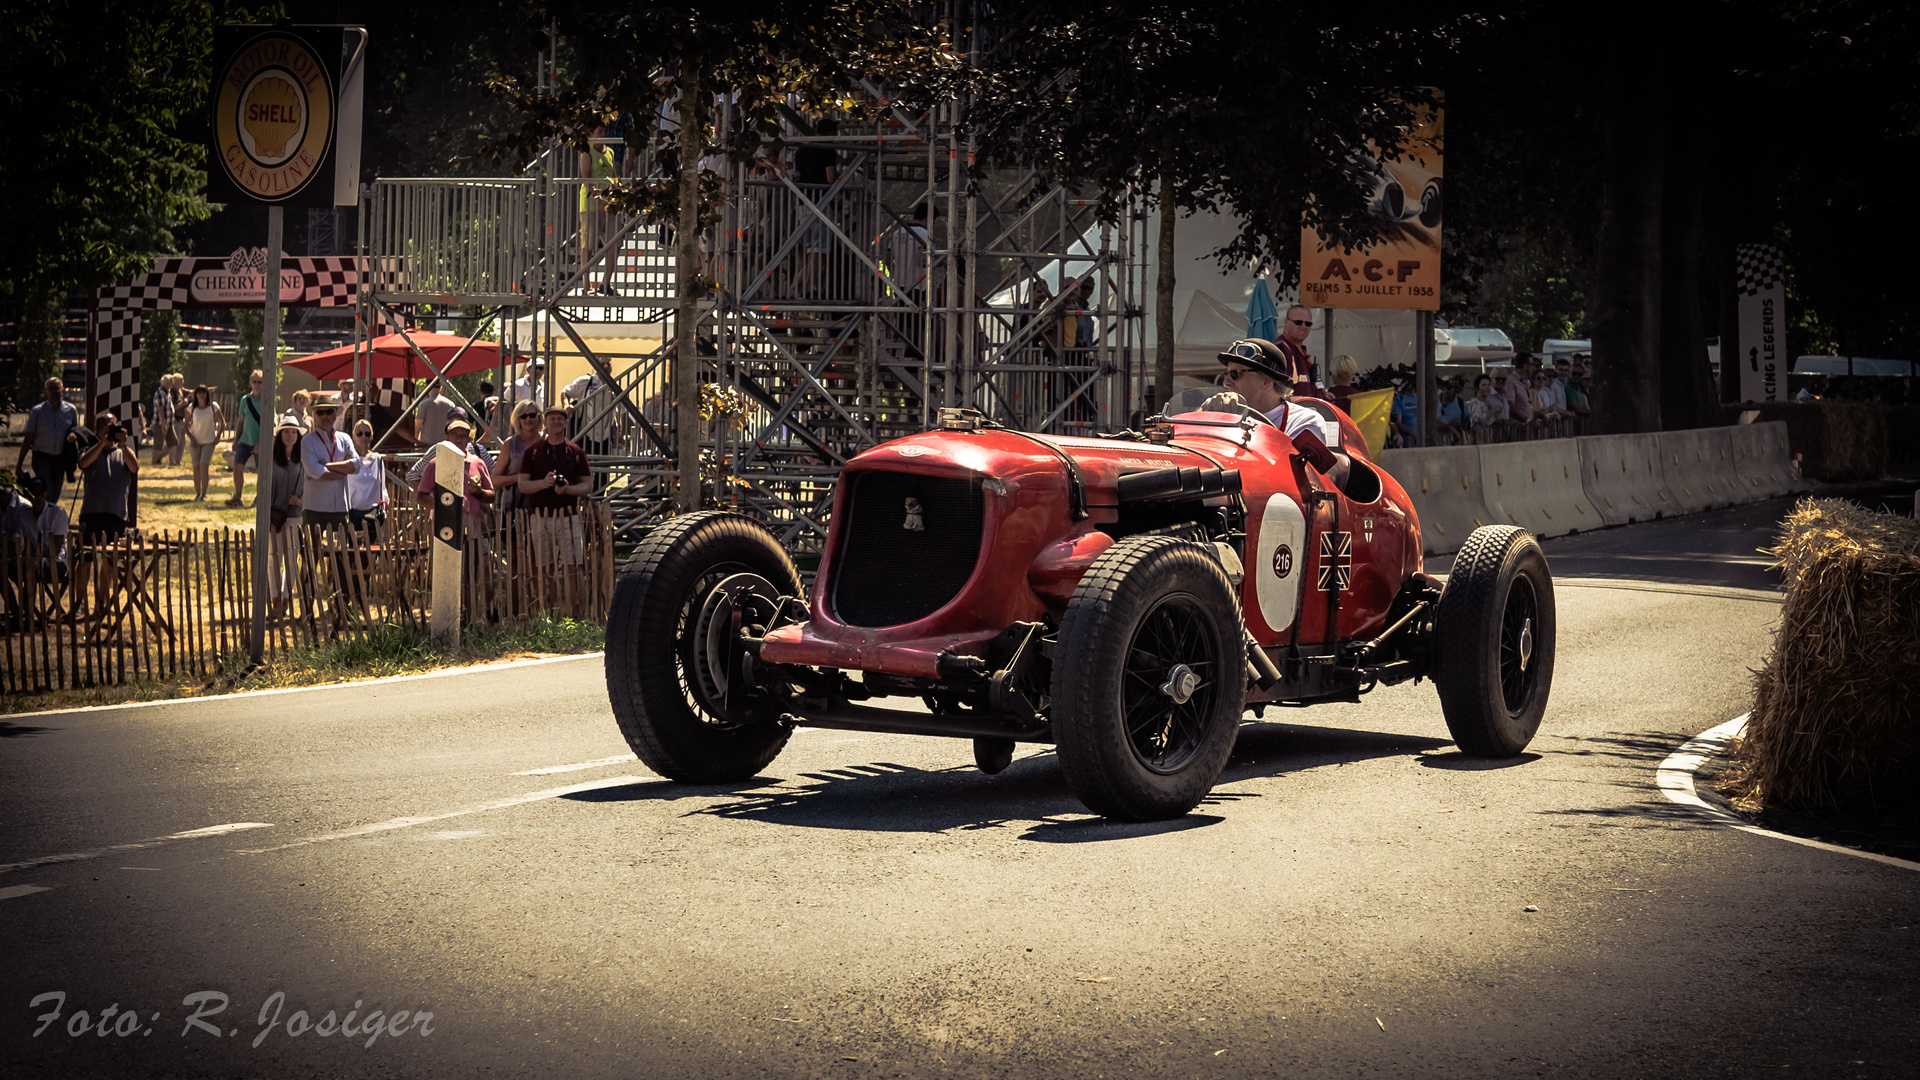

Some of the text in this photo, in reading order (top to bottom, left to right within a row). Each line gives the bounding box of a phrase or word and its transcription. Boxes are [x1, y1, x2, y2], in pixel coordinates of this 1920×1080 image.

[228, 42, 321, 94] MOTOR OIL
[248, 103, 297, 123] SHELL
[226, 143, 315, 193] GASOLINE
[194, 275, 301, 290] CHERRY LNE
[1306, 282, 1434, 297] REIMS 3 JUILLET 1938
[1763, 298, 1777, 403] ACING LEGENDS
[1275, 553, 1290, 571] 216
